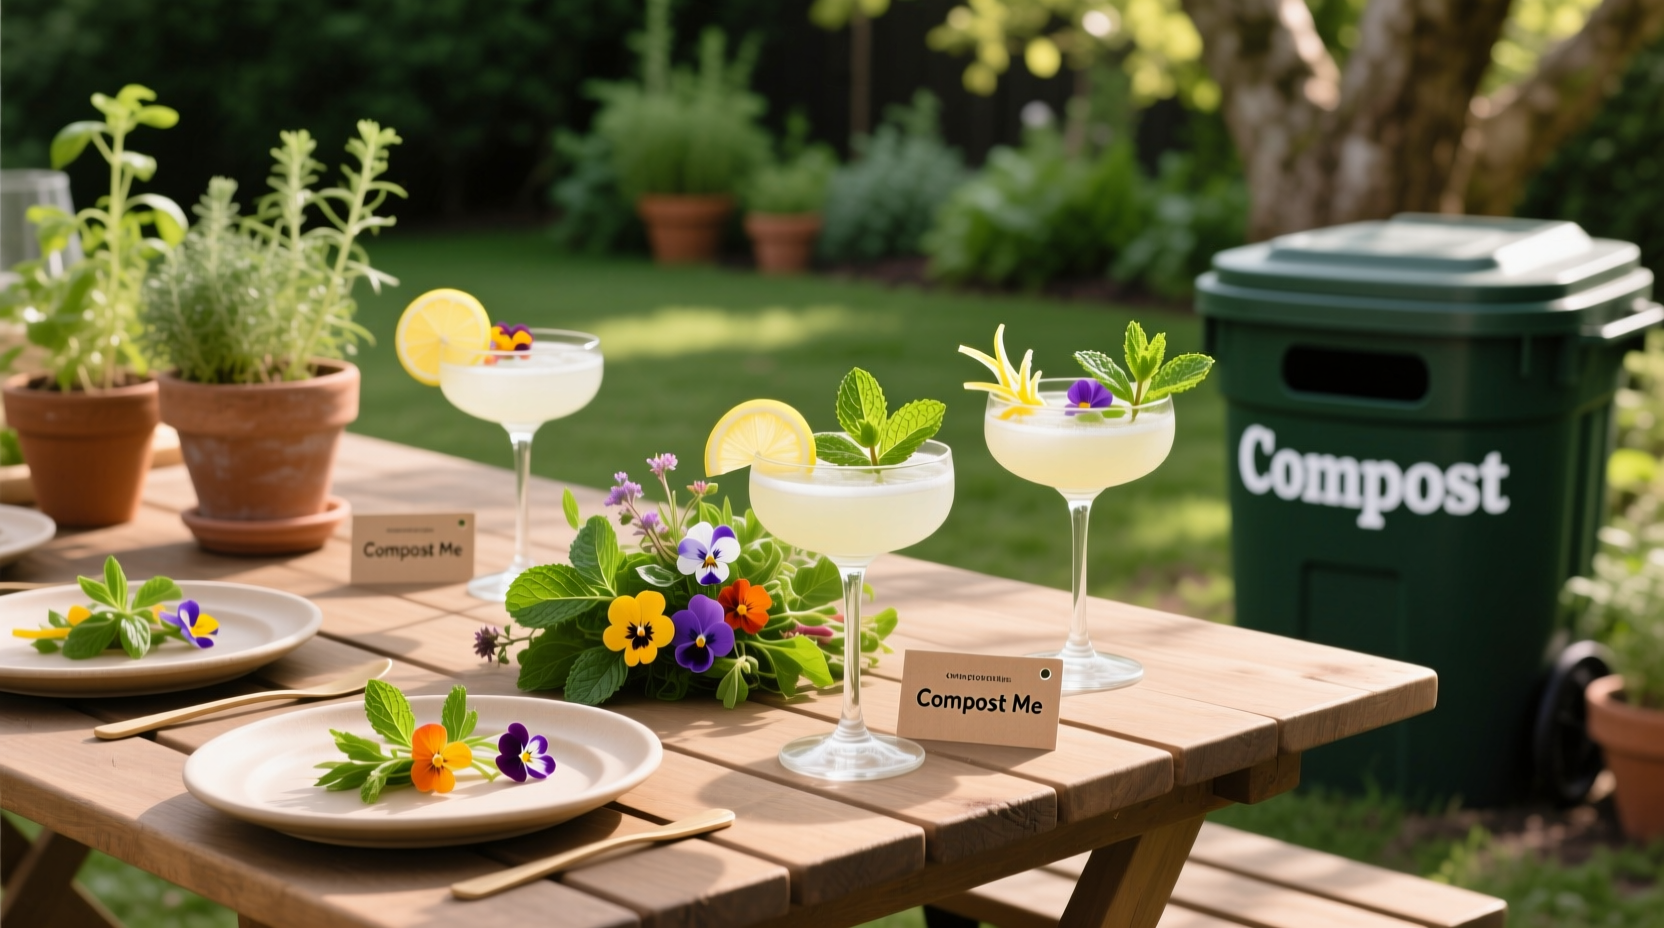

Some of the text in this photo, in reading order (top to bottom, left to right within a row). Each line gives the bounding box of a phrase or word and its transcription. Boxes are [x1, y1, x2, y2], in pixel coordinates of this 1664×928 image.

[1238, 424, 1510, 530] Compost
[363, 541, 463, 561] Compost Me
[916, 687, 1043, 714] Compost Me
